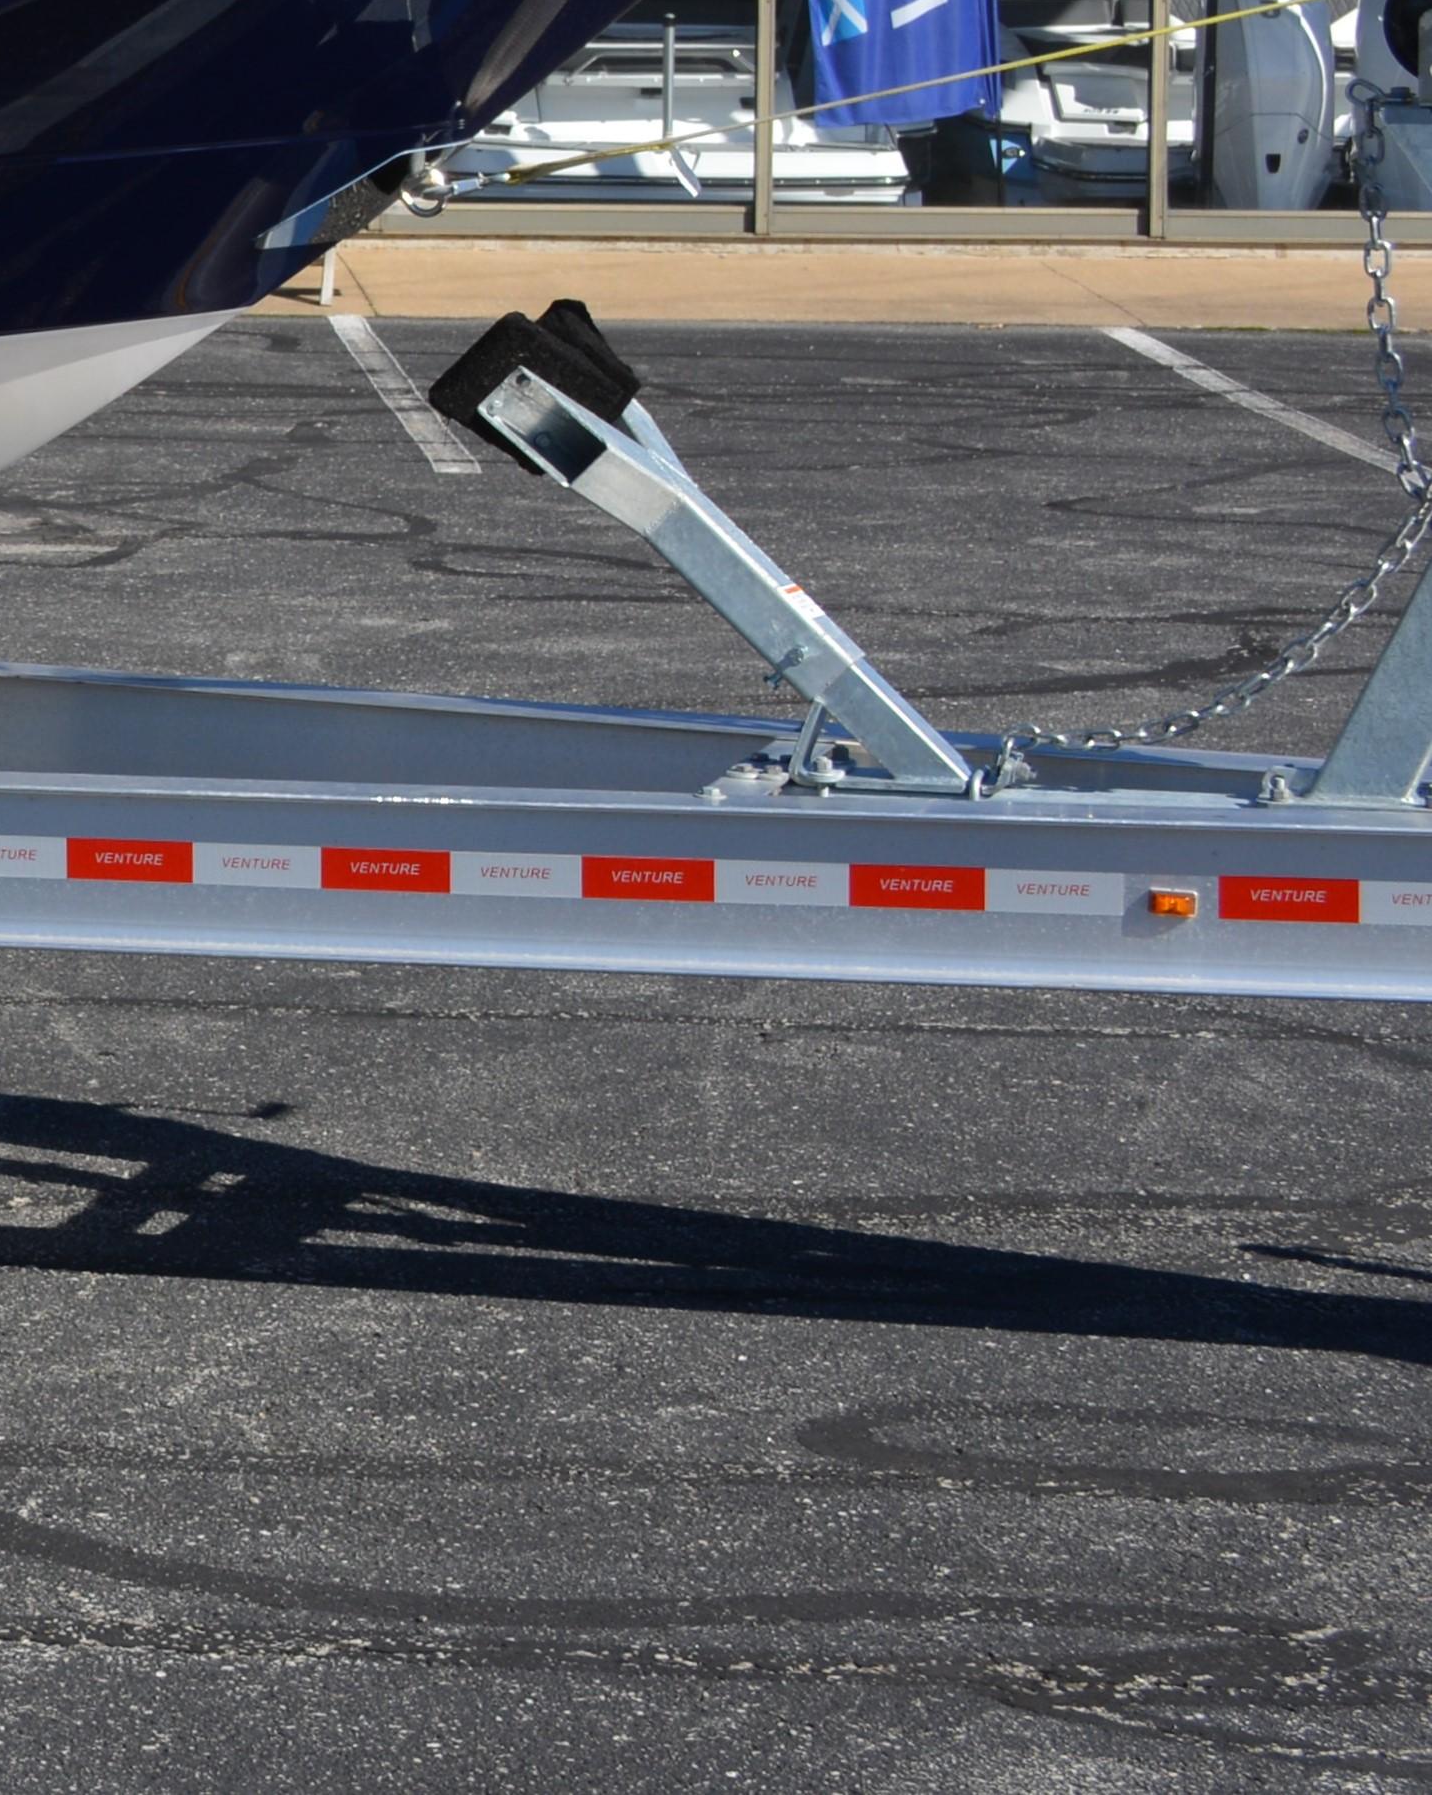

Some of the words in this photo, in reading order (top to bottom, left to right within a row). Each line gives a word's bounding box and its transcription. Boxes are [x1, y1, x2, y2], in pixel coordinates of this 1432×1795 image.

[95, 852, 163, 866] VENTURE
[222, 857, 291, 871] VENTURE
[350, 861, 421, 876] VENTURE
[480, 866, 551, 880] VENTURE
[611, 870, 684, 884] VENTURE
[745, 874, 817, 888] VENTURE
[880, 878, 954, 893] VENTURE
[1016, 883, 1091, 897] VENTURE
[1250, 889, 1327, 903] VENTURE
[1391, 893, 1432, 906] VENT
